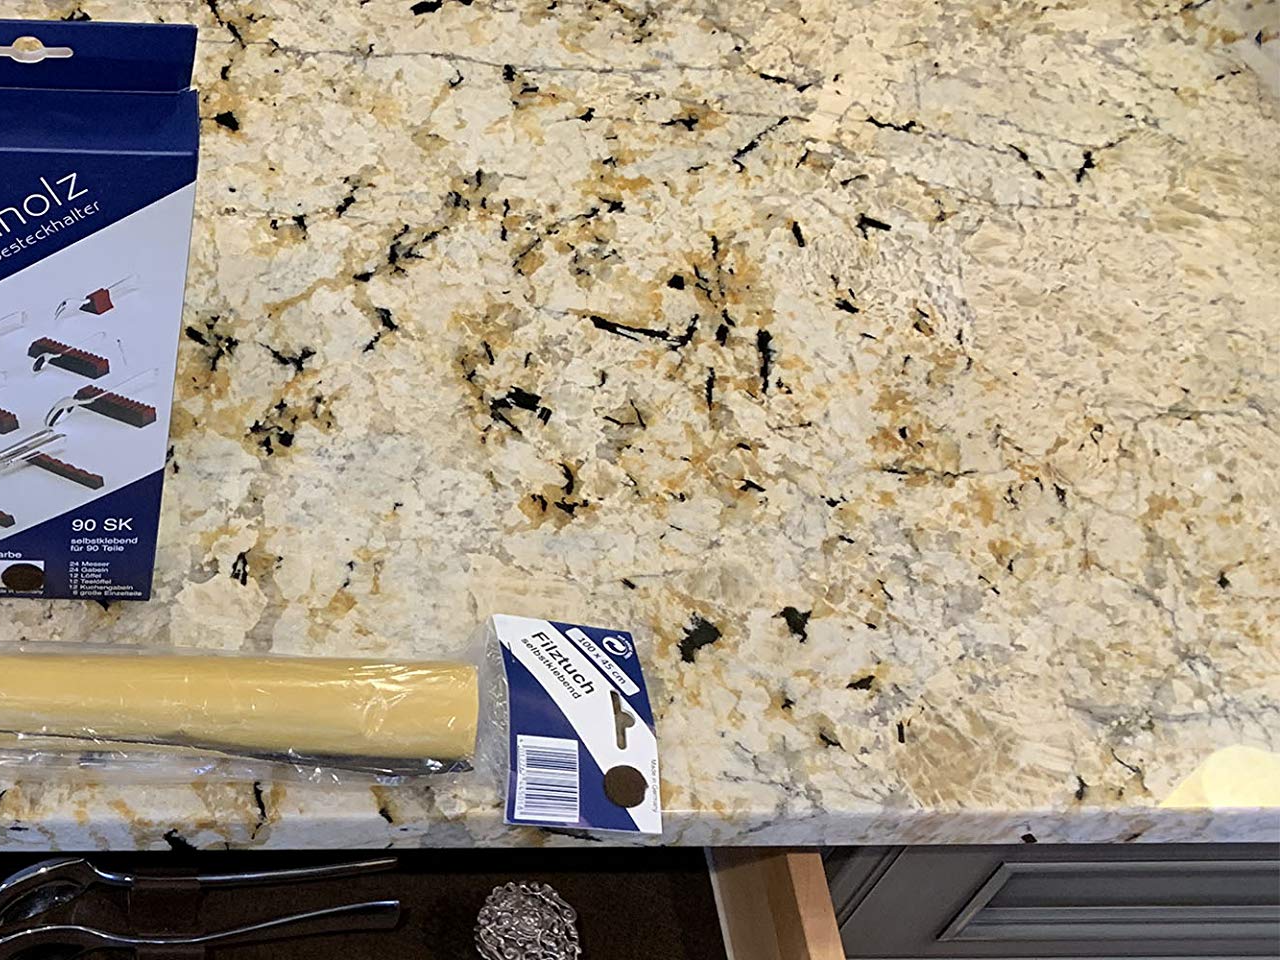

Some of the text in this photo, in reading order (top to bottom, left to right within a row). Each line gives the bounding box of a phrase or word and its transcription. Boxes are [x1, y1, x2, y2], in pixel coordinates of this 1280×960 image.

[70, 537, 138, 545] selbstklebend
[72, 517, 133, 531] 90 SK
[521, 637, 582, 700] selbstklebend
[531, 631, 596, 695] Filztuch
[577, 637, 596, 653] 100
[601, 658, 614, 672] 45
[611, 670, 627, 685] cm
